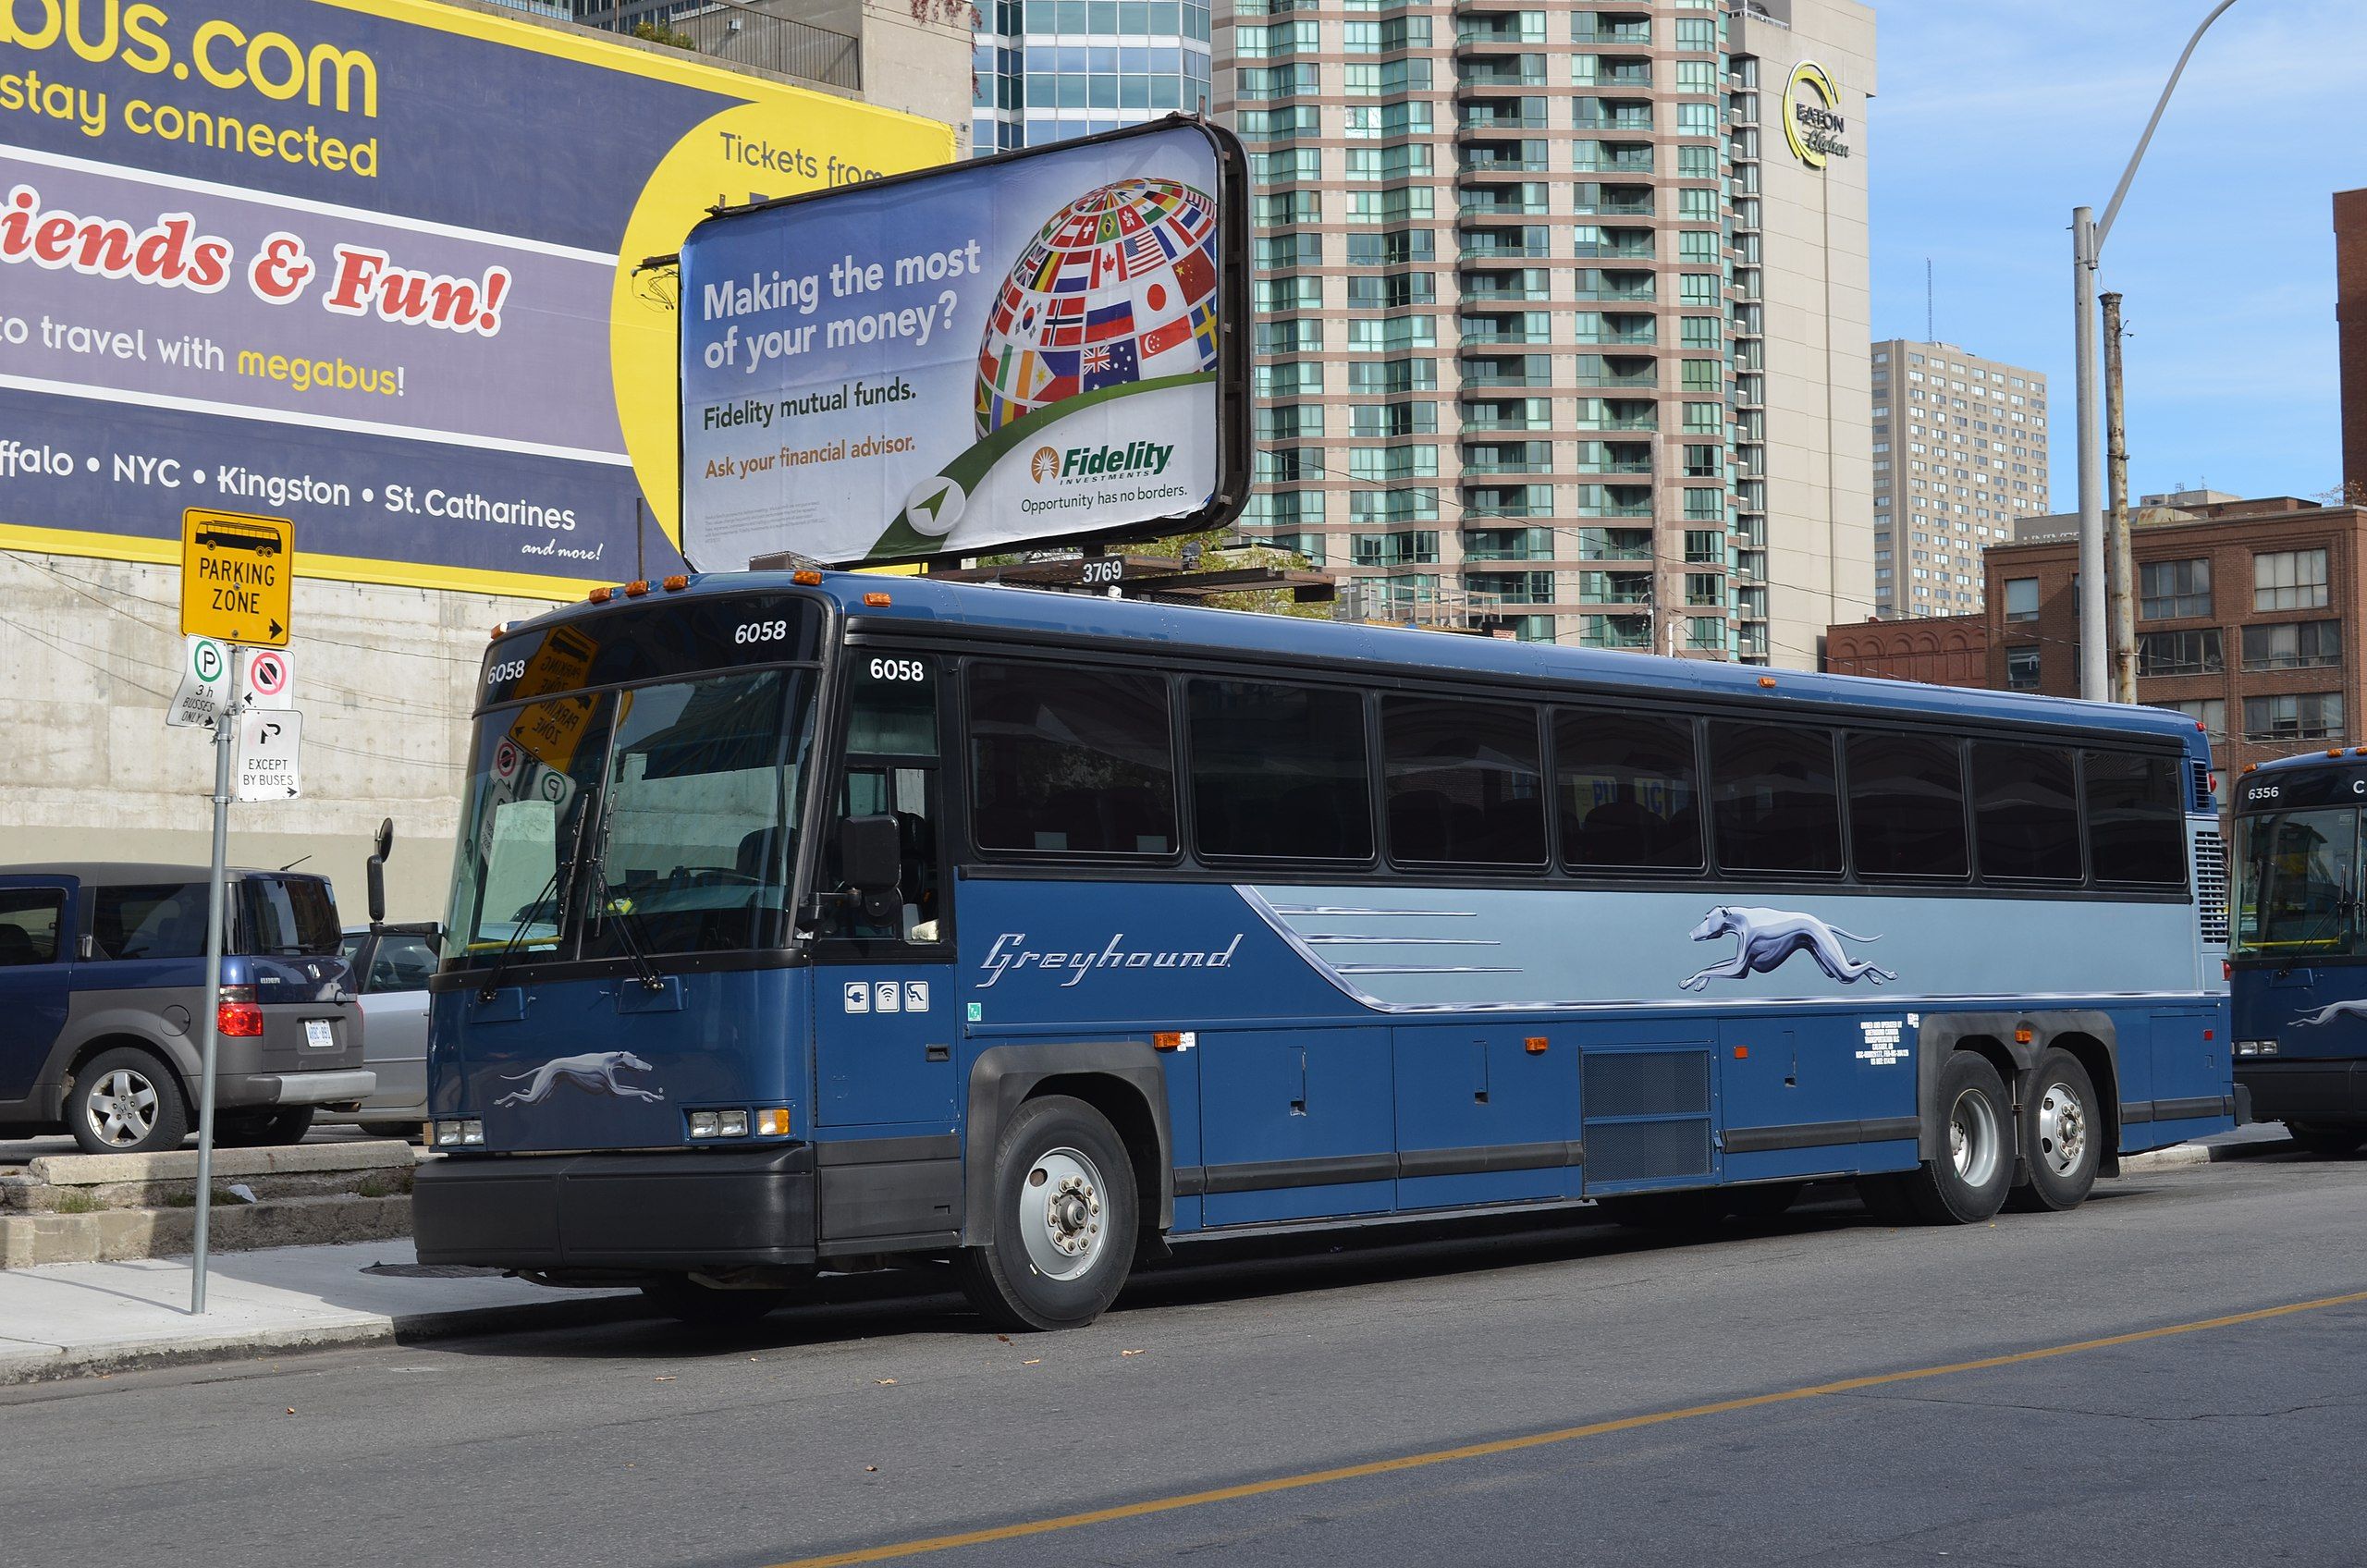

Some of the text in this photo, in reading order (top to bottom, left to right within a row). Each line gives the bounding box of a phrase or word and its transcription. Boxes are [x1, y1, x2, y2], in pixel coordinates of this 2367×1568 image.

[0, 70, 378, 178] stay connected
[1796, 103, 1845, 133] EATON
[720, 131, 884, 188] Tickets fro
[251, 235, 312, 300] &
[326, 246, 509, 334] Fun!
[704, 239, 982, 322] Making the most
[705, 290, 957, 374] of your money?
[0, 315, 405, 397] o travel with megabus!
[705, 376, 916, 431] Fidelity mutual funds.
[705, 435, 916, 481] Ask your financial advisor.
[1061, 441, 1174, 477] Fidelity
[114, 453, 181, 488] NYC
[217, 465, 350, 507] Kingston
[385, 484, 421, 515] St.
[424, 490, 575, 531] Catharines
[1060, 470, 1150, 485] INVESTMENTS
[1021, 484, 1188, 515] Opportunity has no borders.
[521, 539, 603, 560] and more!
[199, 557, 275, 587] PARKING
[1083, 560, 1122, 583] 3769
[212, 589, 260, 614] ZONE
[734, 619, 787, 645] 6058
[487, 659, 525, 684] 6058
[870, 657, 924, 681] 6058
[182, 697, 215, 713] BUSSES
[195, 684, 214, 698] 3 h
[181, 710, 203, 724] ONLY
[248, 758, 288, 770] EXCEPT
[243, 775, 294, 785] BY BUSES
[2248, 786, 2279, 800] 6356
[975, 933, 1244, 988] Greyhound
